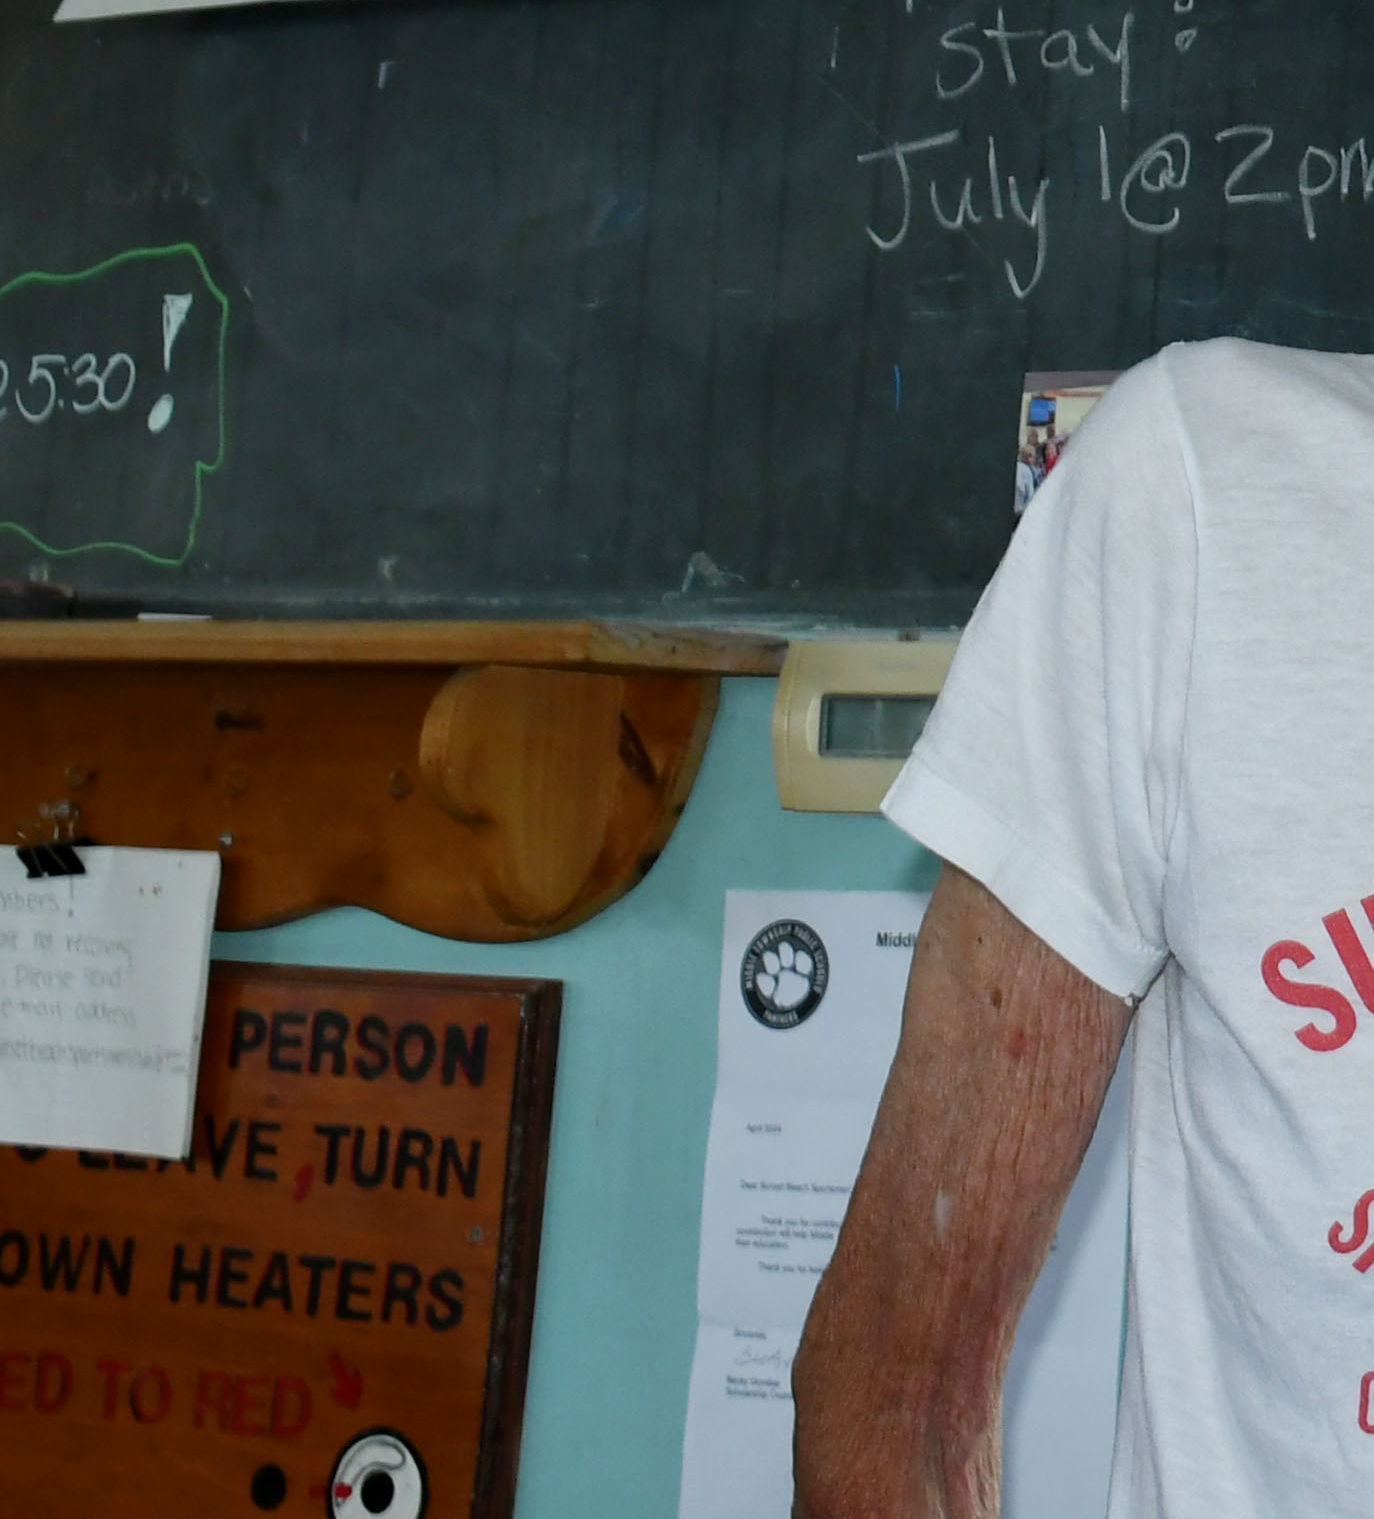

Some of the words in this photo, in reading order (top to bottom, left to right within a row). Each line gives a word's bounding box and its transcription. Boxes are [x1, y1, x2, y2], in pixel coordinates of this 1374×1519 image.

[857, 129, 1050, 298] July
[229, 1008, 488, 1086] PERSON
[315, 1124, 481, 1198] TURN
[169, 1243, 464, 1331] HEATERS
[97, 1357, 172, 1425] TO
[194, 1370, 313, 1438] RED
